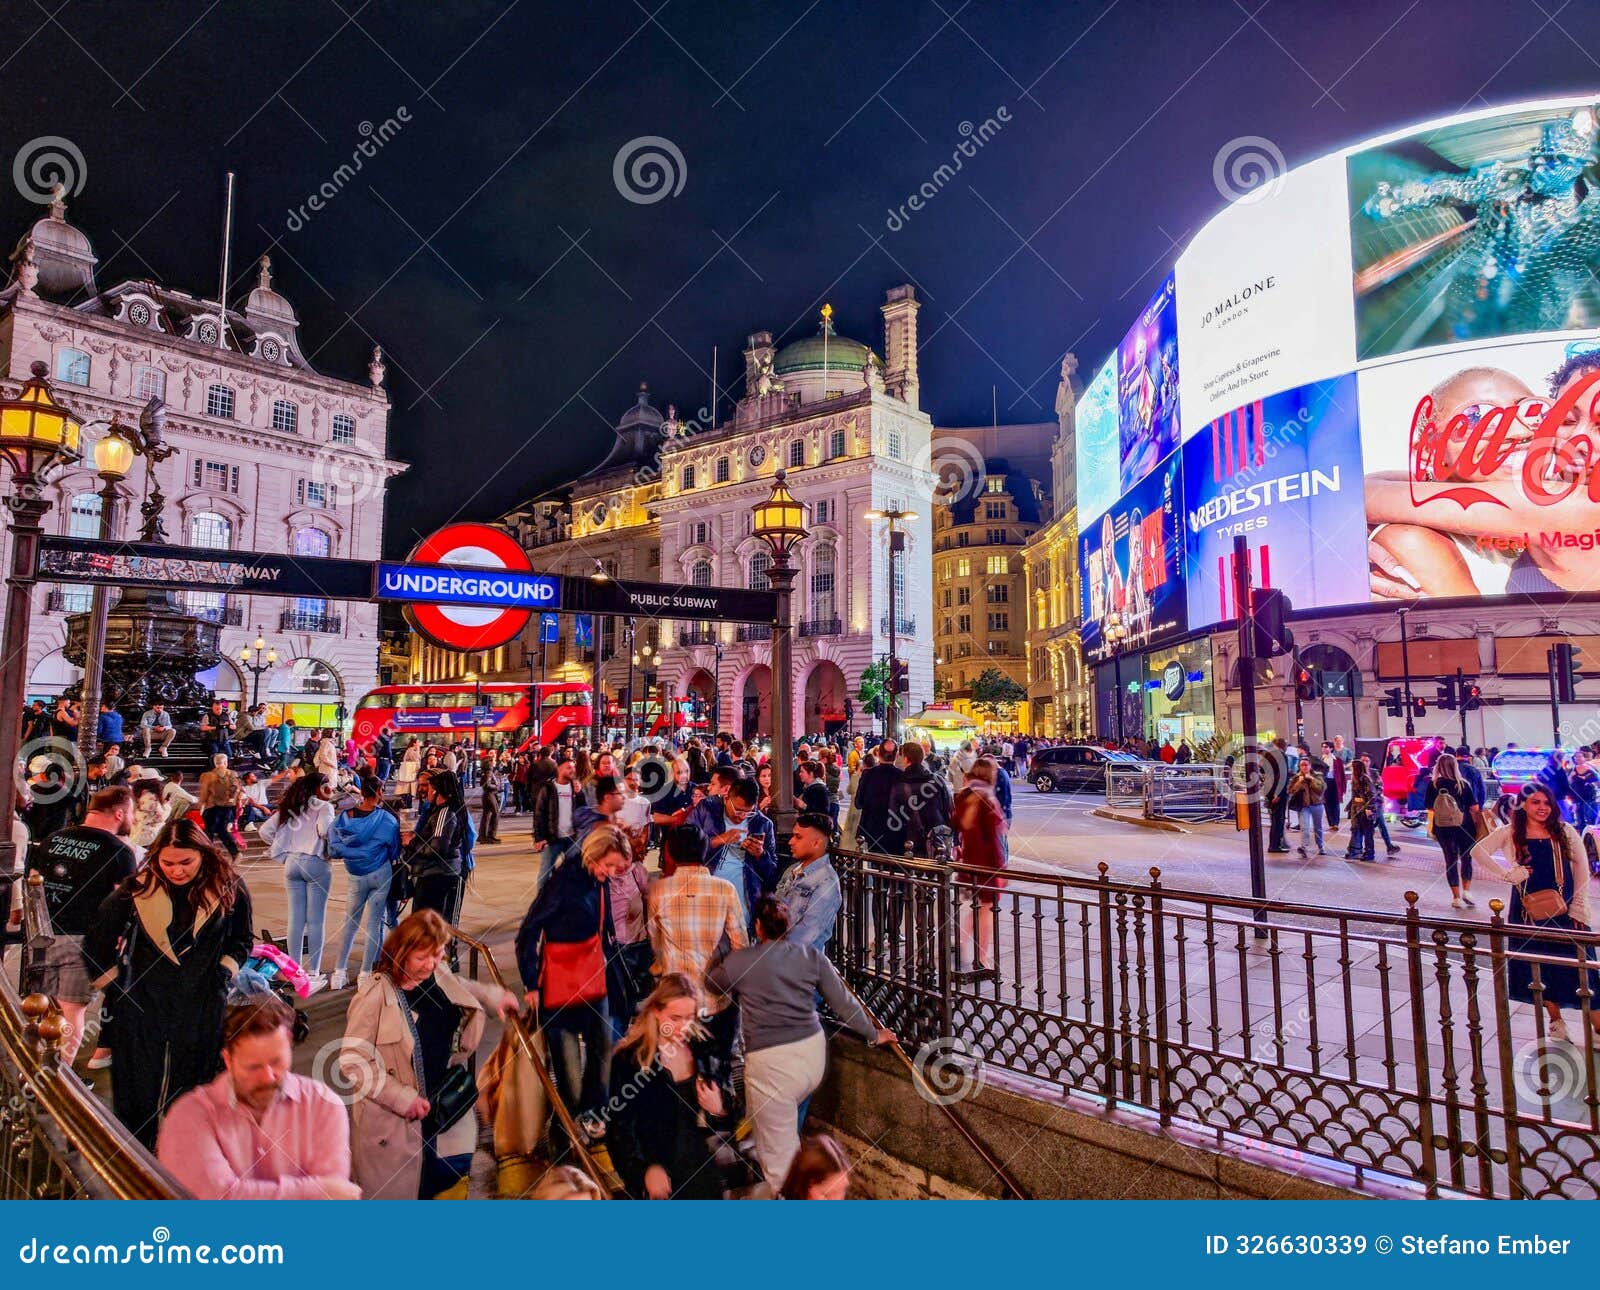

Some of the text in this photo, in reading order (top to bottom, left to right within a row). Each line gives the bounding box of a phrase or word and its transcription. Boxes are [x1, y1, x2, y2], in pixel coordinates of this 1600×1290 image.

[1201, 276, 1275, 328] JO MALONE
[1242, 348, 1281, 369] Grapevine
[1249, 369, 1270, 382] Store
[1189, 465, 1341, 533] VREDESTEIN
[1217, 516, 1269, 540] TYRES
[1475, 532, 1530, 552] Real
[385, 573, 554, 600] UNDERGROUND
[630, 593, 718, 609] PUBLIC SUBWAY
[48, 844, 90, 860] JEANS
[76, 841, 101, 851] KLEIN
